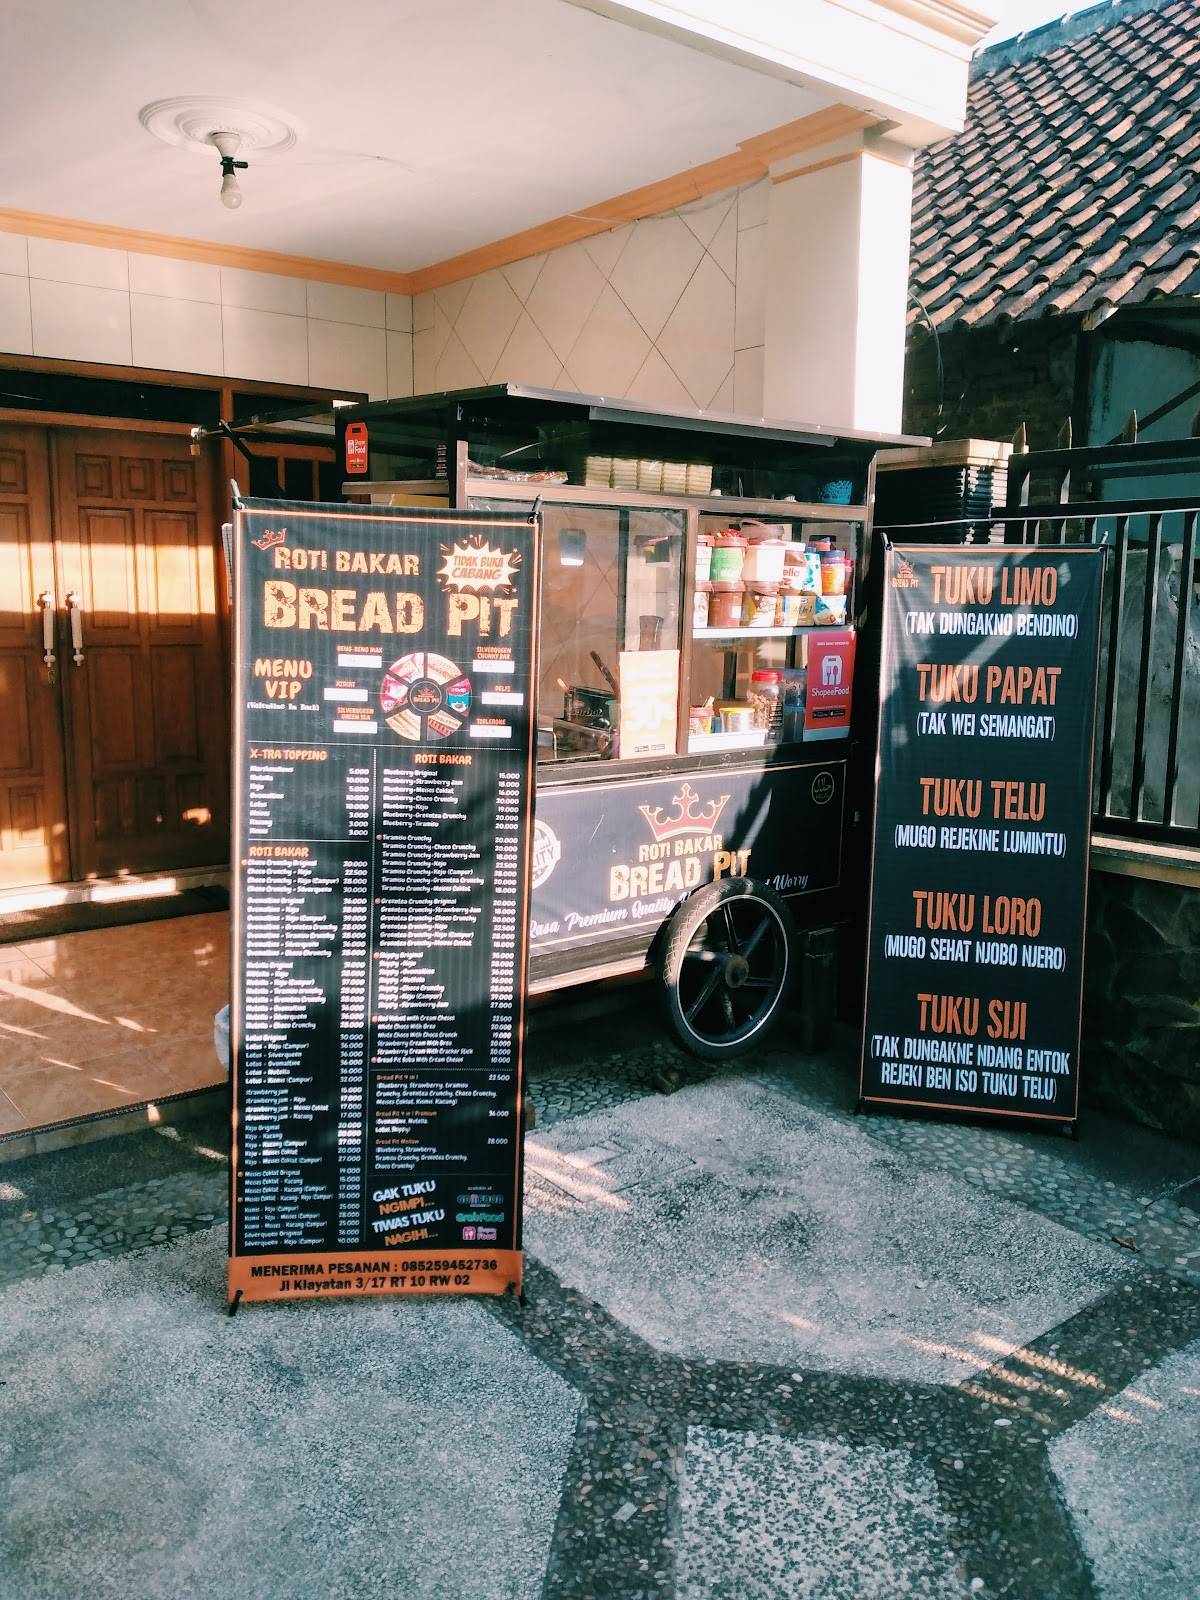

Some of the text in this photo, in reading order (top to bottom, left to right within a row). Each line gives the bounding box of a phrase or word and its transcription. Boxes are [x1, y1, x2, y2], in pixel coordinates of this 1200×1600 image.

[274, 546, 420, 576] ROTI BAKAR
[451, 568, 501, 579] CABANG
[454, 555, 504, 568] TIDAK BUKA
[930, 565, 1058, 606] TUKU LIMO
[263, 579, 519, 637] BREAD PIT
[905, 611, 1079, 639] (TAK DUNGAKNO BENDINO)
[254, 658, 313, 679] MENU
[265, 680, 303, 699] VIP
[811, 687, 851, 698] ShopeeFood
[917, 663, 1062, 706] TUKU PAPAT
[916, 711, 1056, 742] (TAK WEI SEMANGAT)
[250, 749, 328, 761] X-TRA TOPPING
[415, 753, 472, 766] ROTI BAKAR
[919, 776, 1047, 822] TUKU TELU
[250, 847, 310, 858] ROTI BAKAR
[638, 834, 724, 864] ROTI BAKAR
[894, 823, 1067, 859] (MUGO REJEKINE LUMINTU)
[609, 857, 702, 902] BREAD
[712, 848, 752, 881] PIT
[772, 873, 809, 891] Worry
[564, 907, 629, 931] Premium
[631, 896, 677, 920] Quality
[912, 890, 1042, 938] TUKU LORO
[884, 933, 1067, 973] (MUGO SEHAT NJOBO NJERO)
[916, 993, 1029, 1041] TUKU SIJI
[870, 1034, 1071, 1075] (TAK DUNGAKNE NDANG ENTOK
[881, 1062, 1058, 1104] REJEKI BEN ISO TUKU TELU)
[372, 1179, 436, 1202] GAK TUKU
[379, 1196, 436, 1215] NGIMPI...
[371, 1208, 446, 1233] TIWAS TUKU
[384, 1228, 439, 1246] NAGIHI...
[251, 1264, 324, 1278] MENERIMA
[328, 1261, 391, 1275] PESANAN
[401, 1258, 498, 1272] 085259452736
[293, 1278, 352, 1292] Klayatan
[355, 1276, 387, 1291] 3/17
[390, 1275, 407, 1288] RT
[410, 1275, 426, 1287] 10
[429, 1275, 451, 1287] RW
[454, 1274, 471, 1286] 02
